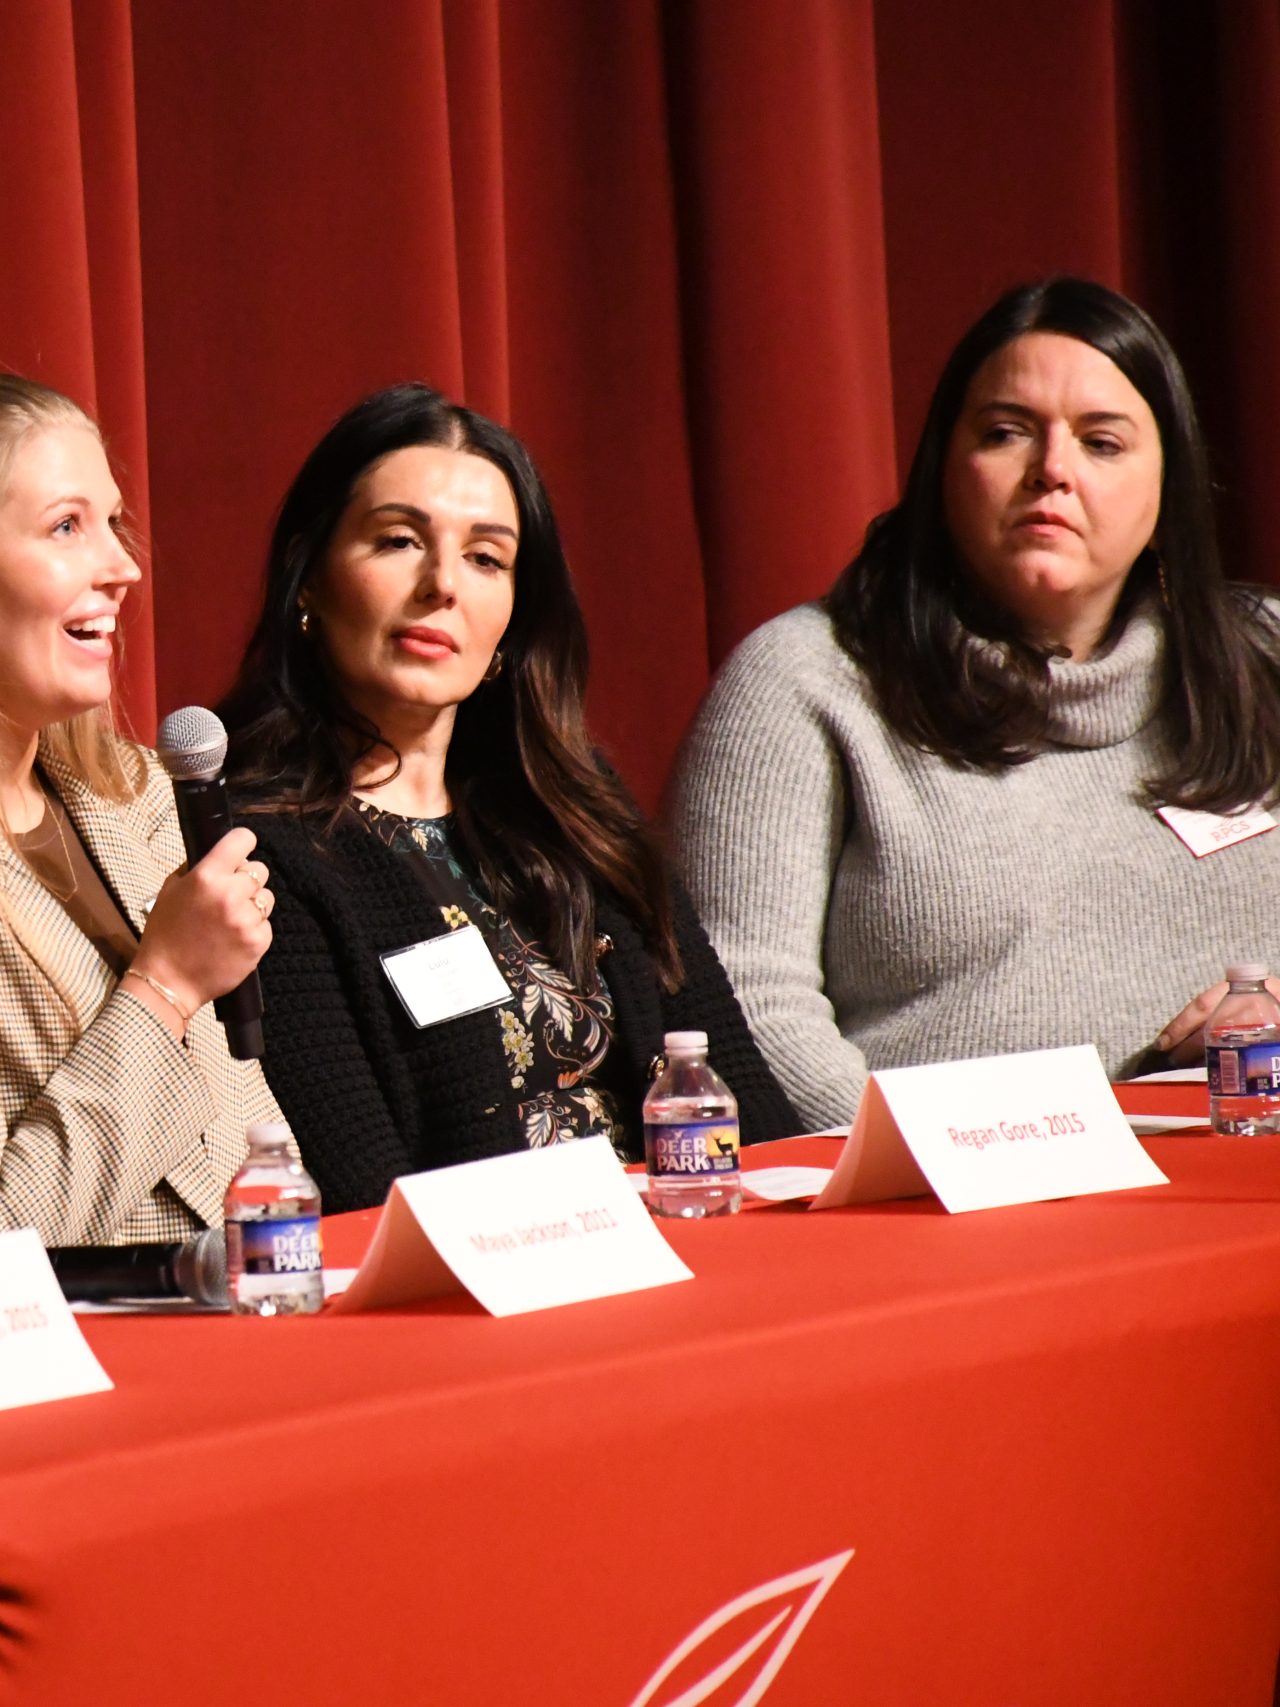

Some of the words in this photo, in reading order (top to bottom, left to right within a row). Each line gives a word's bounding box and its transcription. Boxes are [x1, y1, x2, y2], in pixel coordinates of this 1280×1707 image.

[656, 1137, 706, 1154] DEER
[948, 1126, 999, 1150] Regan
[999, 1121, 1048, 1141] Gore,
[1044, 1112, 1086, 1136] 2015
[657, 1154, 710, 1173] PARK
[470, 1232, 518, 1255] Maya
[575, 1207, 619, 1232] 2011
[3, 1303, 50, 1332] 2015
